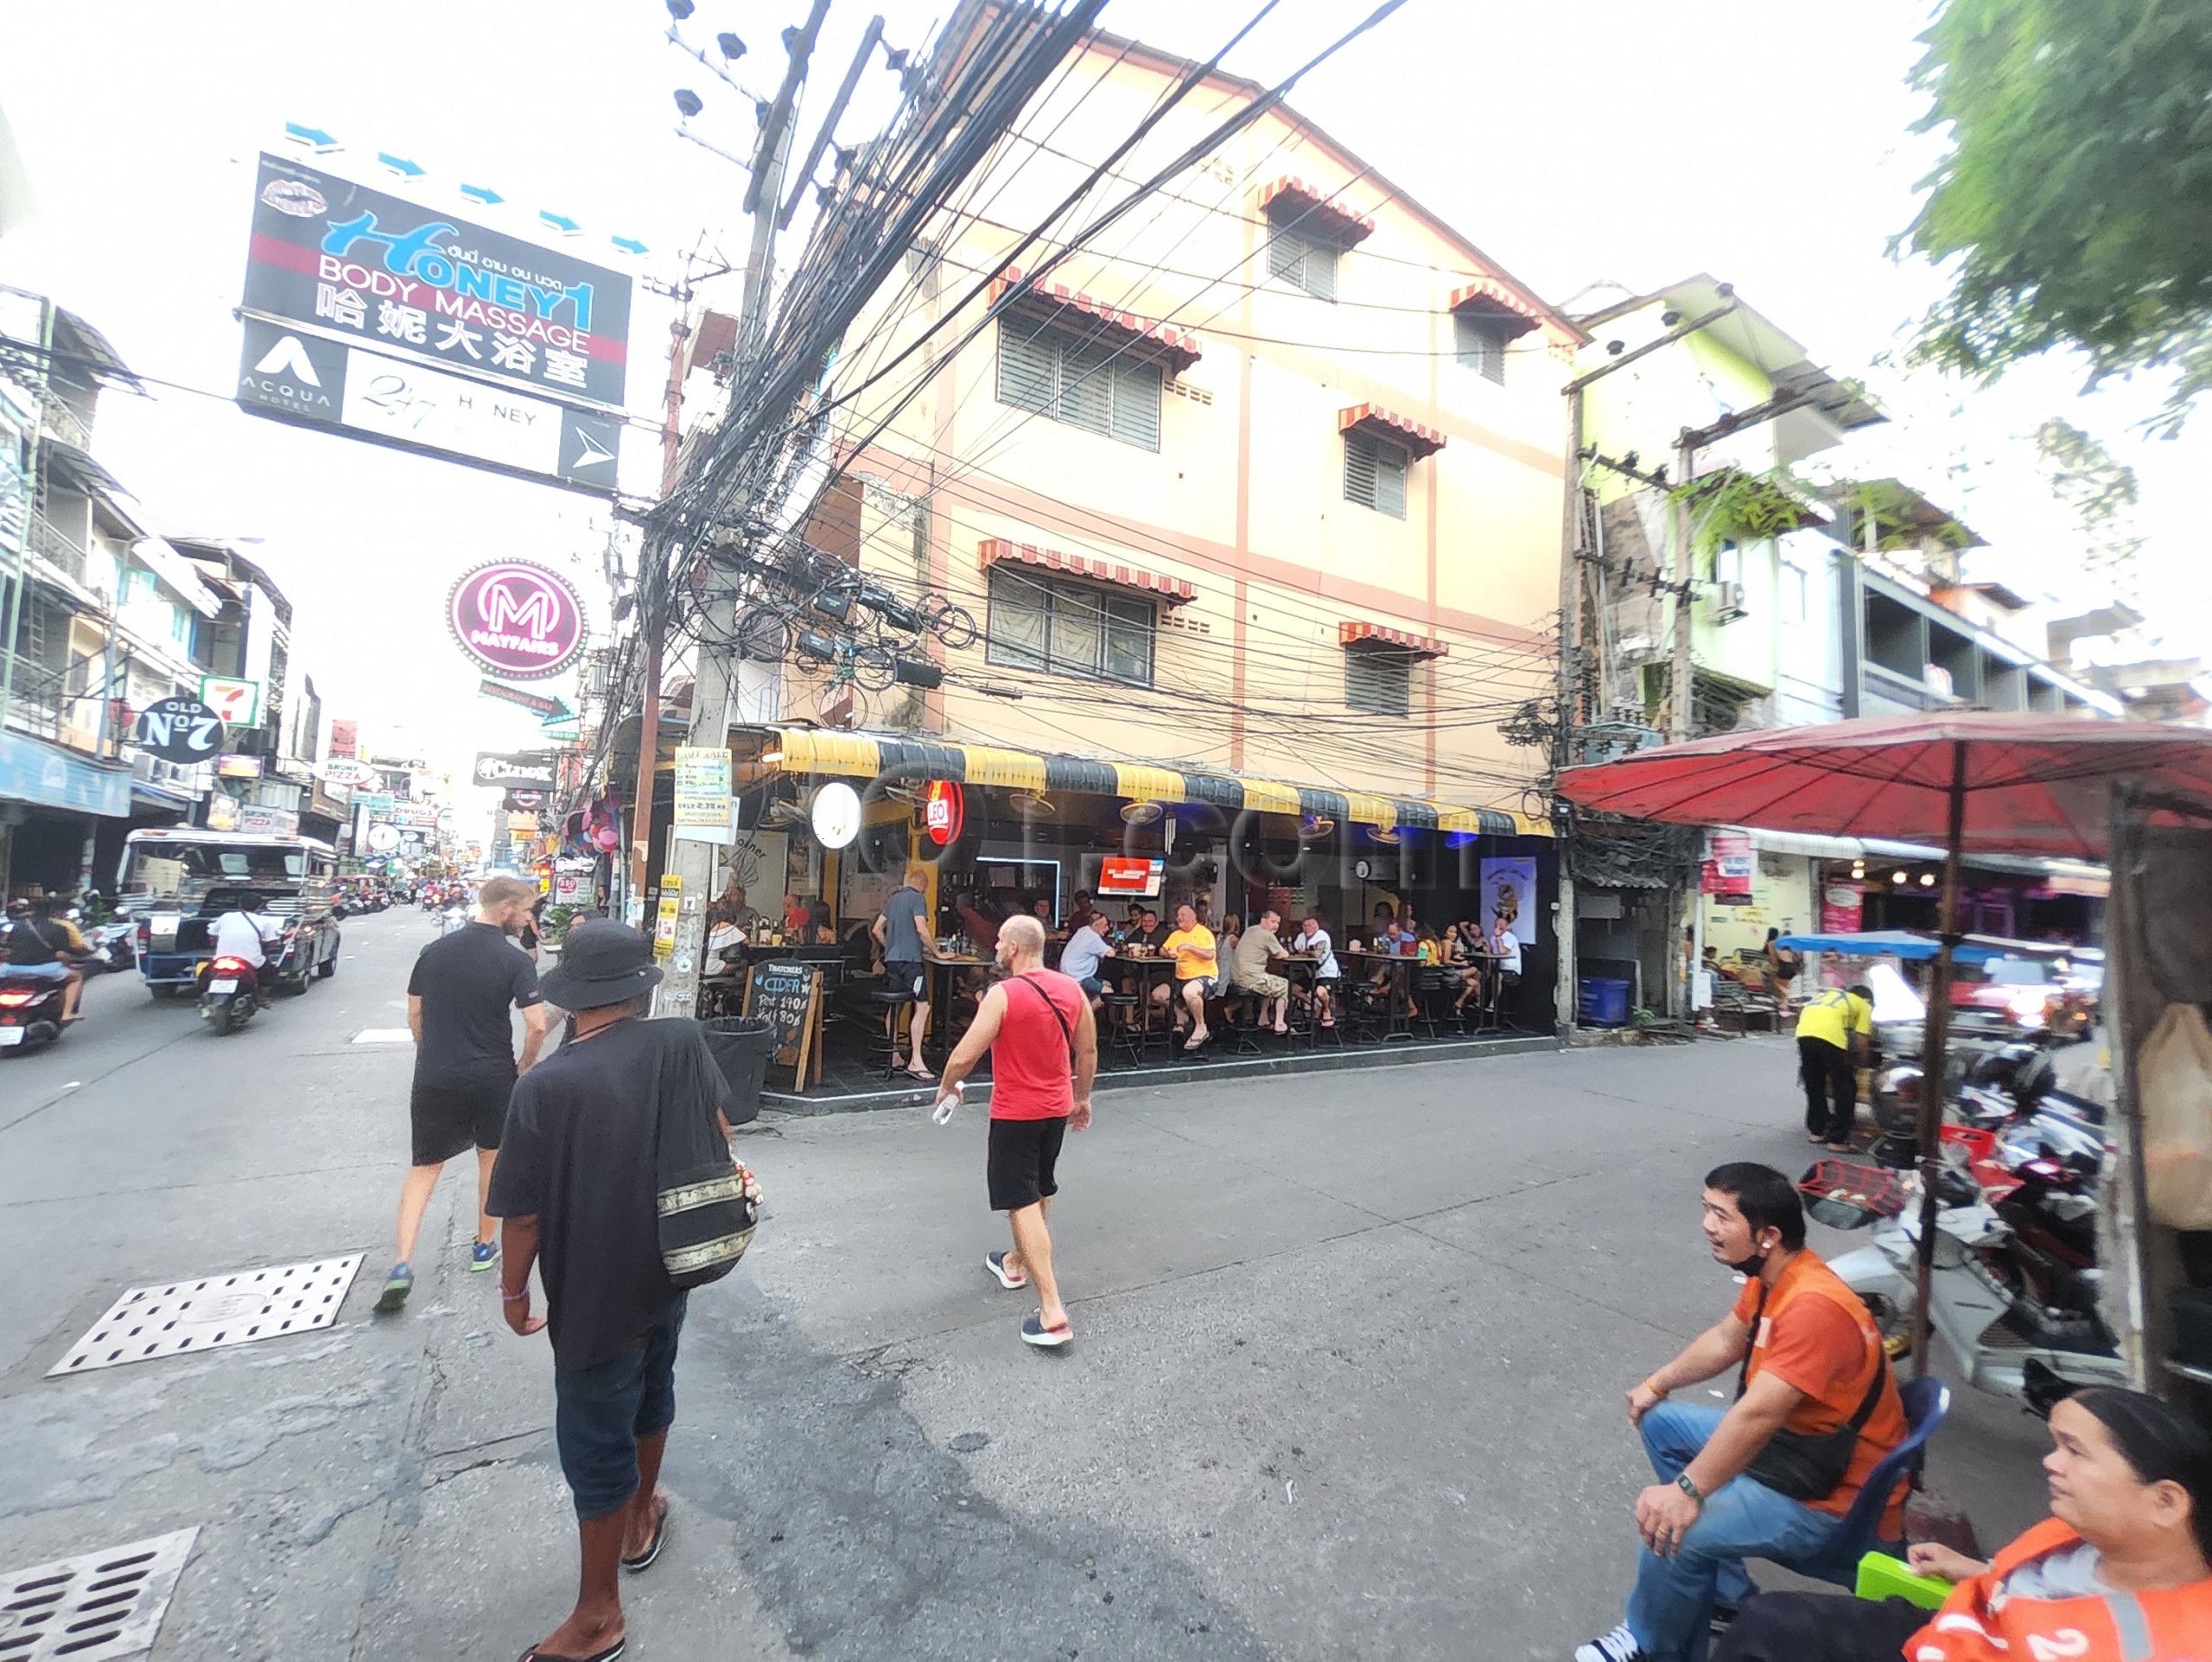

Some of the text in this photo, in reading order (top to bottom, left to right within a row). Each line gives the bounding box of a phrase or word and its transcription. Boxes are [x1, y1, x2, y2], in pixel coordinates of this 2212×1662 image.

[319, 254, 592, 353] BODY MASSAGE
[315, 283, 588, 389] 哈妮大浴室
[241, 375, 332, 408] ACQUA
[259, 393, 311, 413] HOTEL
[165, 701, 203, 714] OLD
[324, 770, 361, 780] PIZZA
[928, 803, 945, 823] LEO
[738, 837, 767, 860] orner
[764, 977, 800, 994] CIDER
